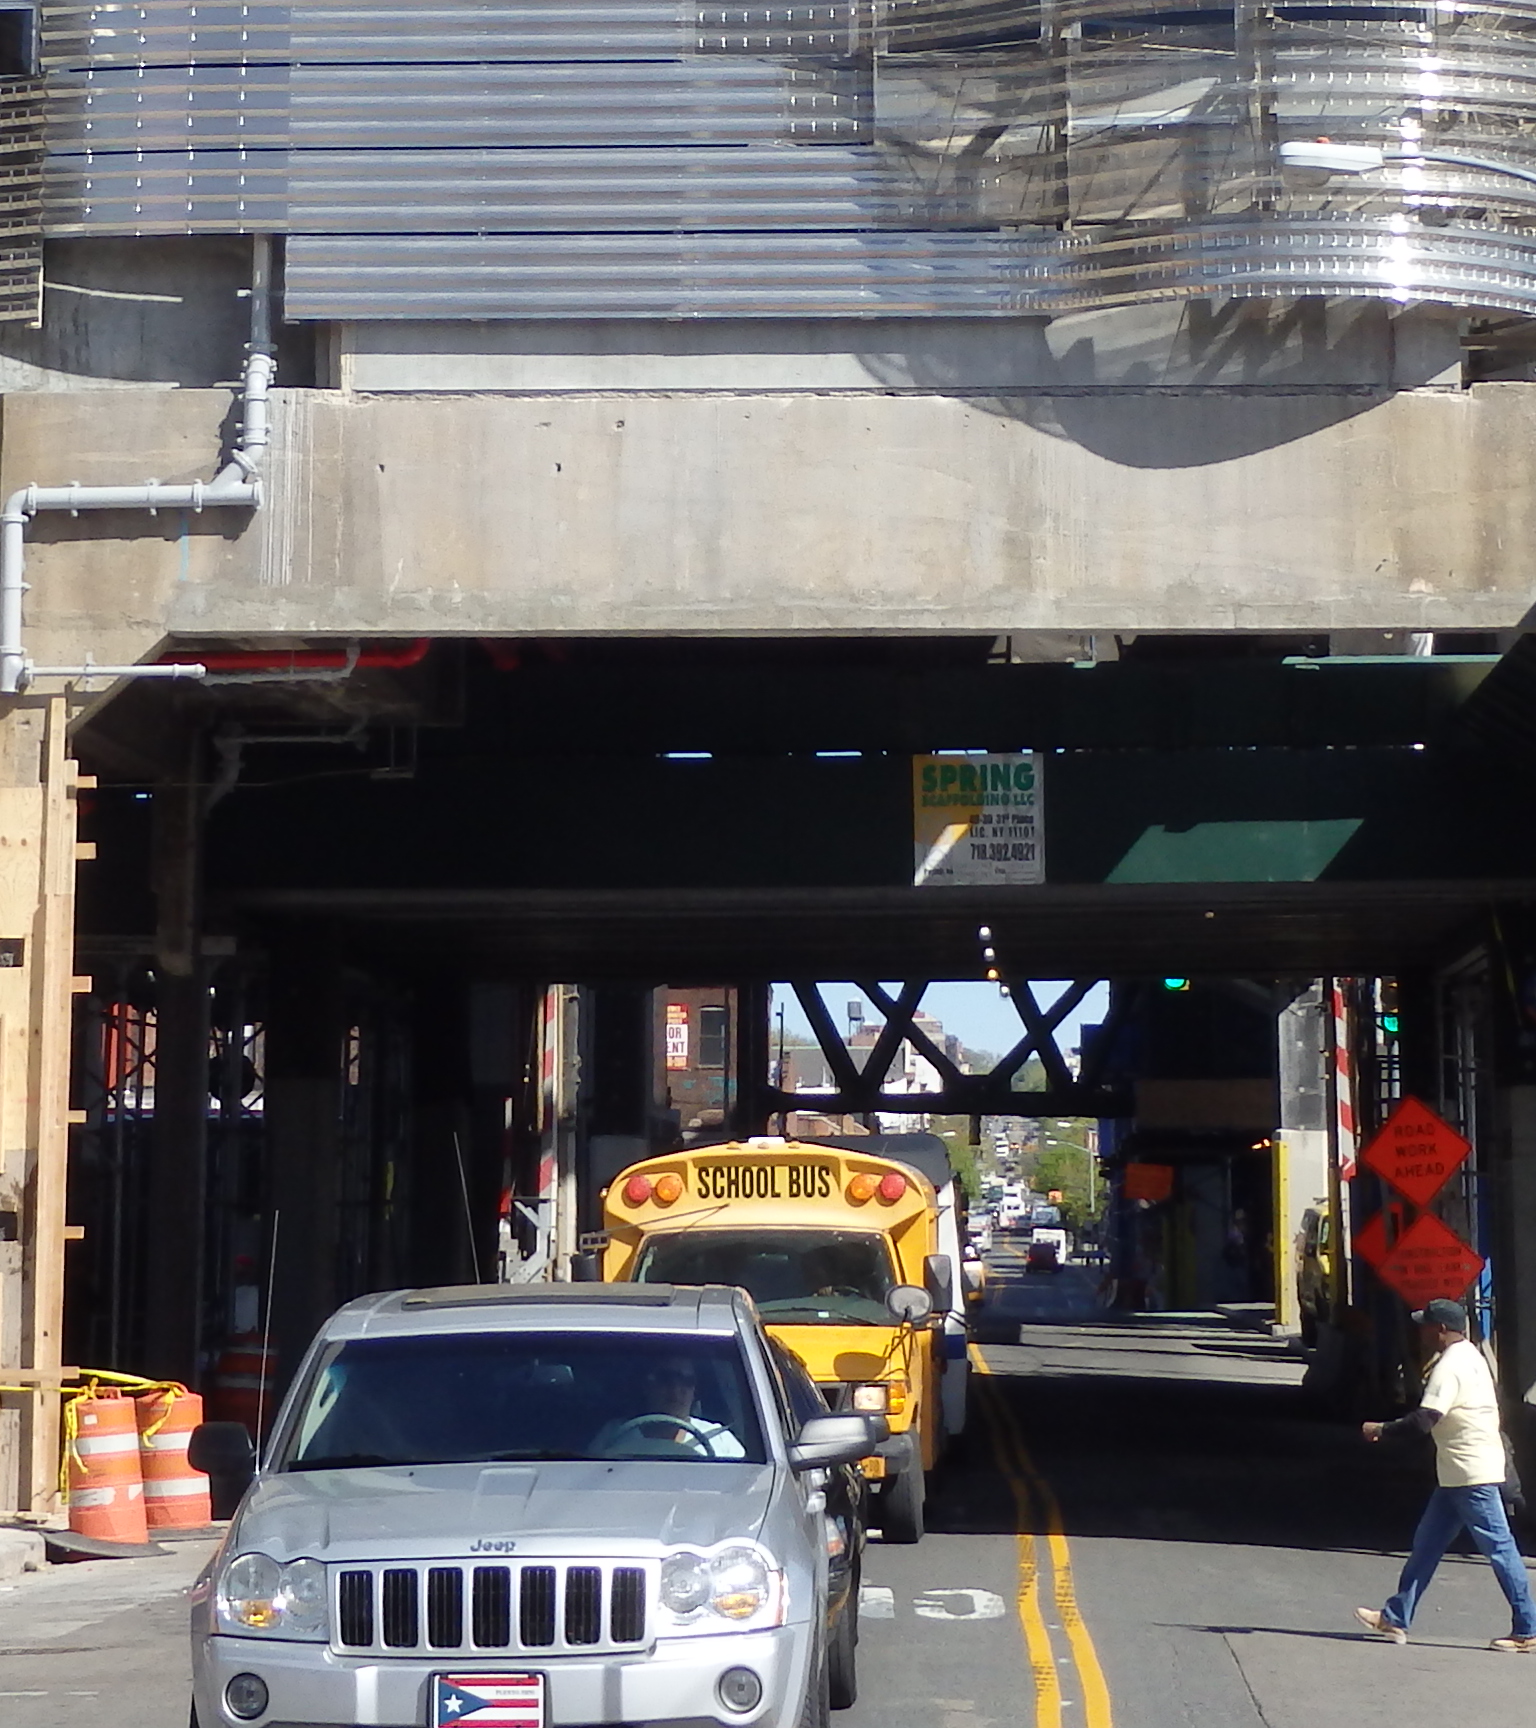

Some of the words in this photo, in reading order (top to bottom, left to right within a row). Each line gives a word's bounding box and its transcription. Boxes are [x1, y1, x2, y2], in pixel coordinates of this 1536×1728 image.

[921, 762, 1035, 792] SPRING
[1014, 793, 1035, 806] LLC
[992, 826, 1005, 837] NY
[668, 1026, 682, 1039] OR
[667, 1041, 686, 1053] ENT
[1394, 1122, 1436, 1139] ROAD
[1395, 1143, 1438, 1158] WORK
[1394, 1162, 1445, 1178] AHEAD
[697, 1165, 781, 1199] SCHOOL
[788, 1164, 831, 1198] BUS
[470, 1539, 517, 1553] Jeep
